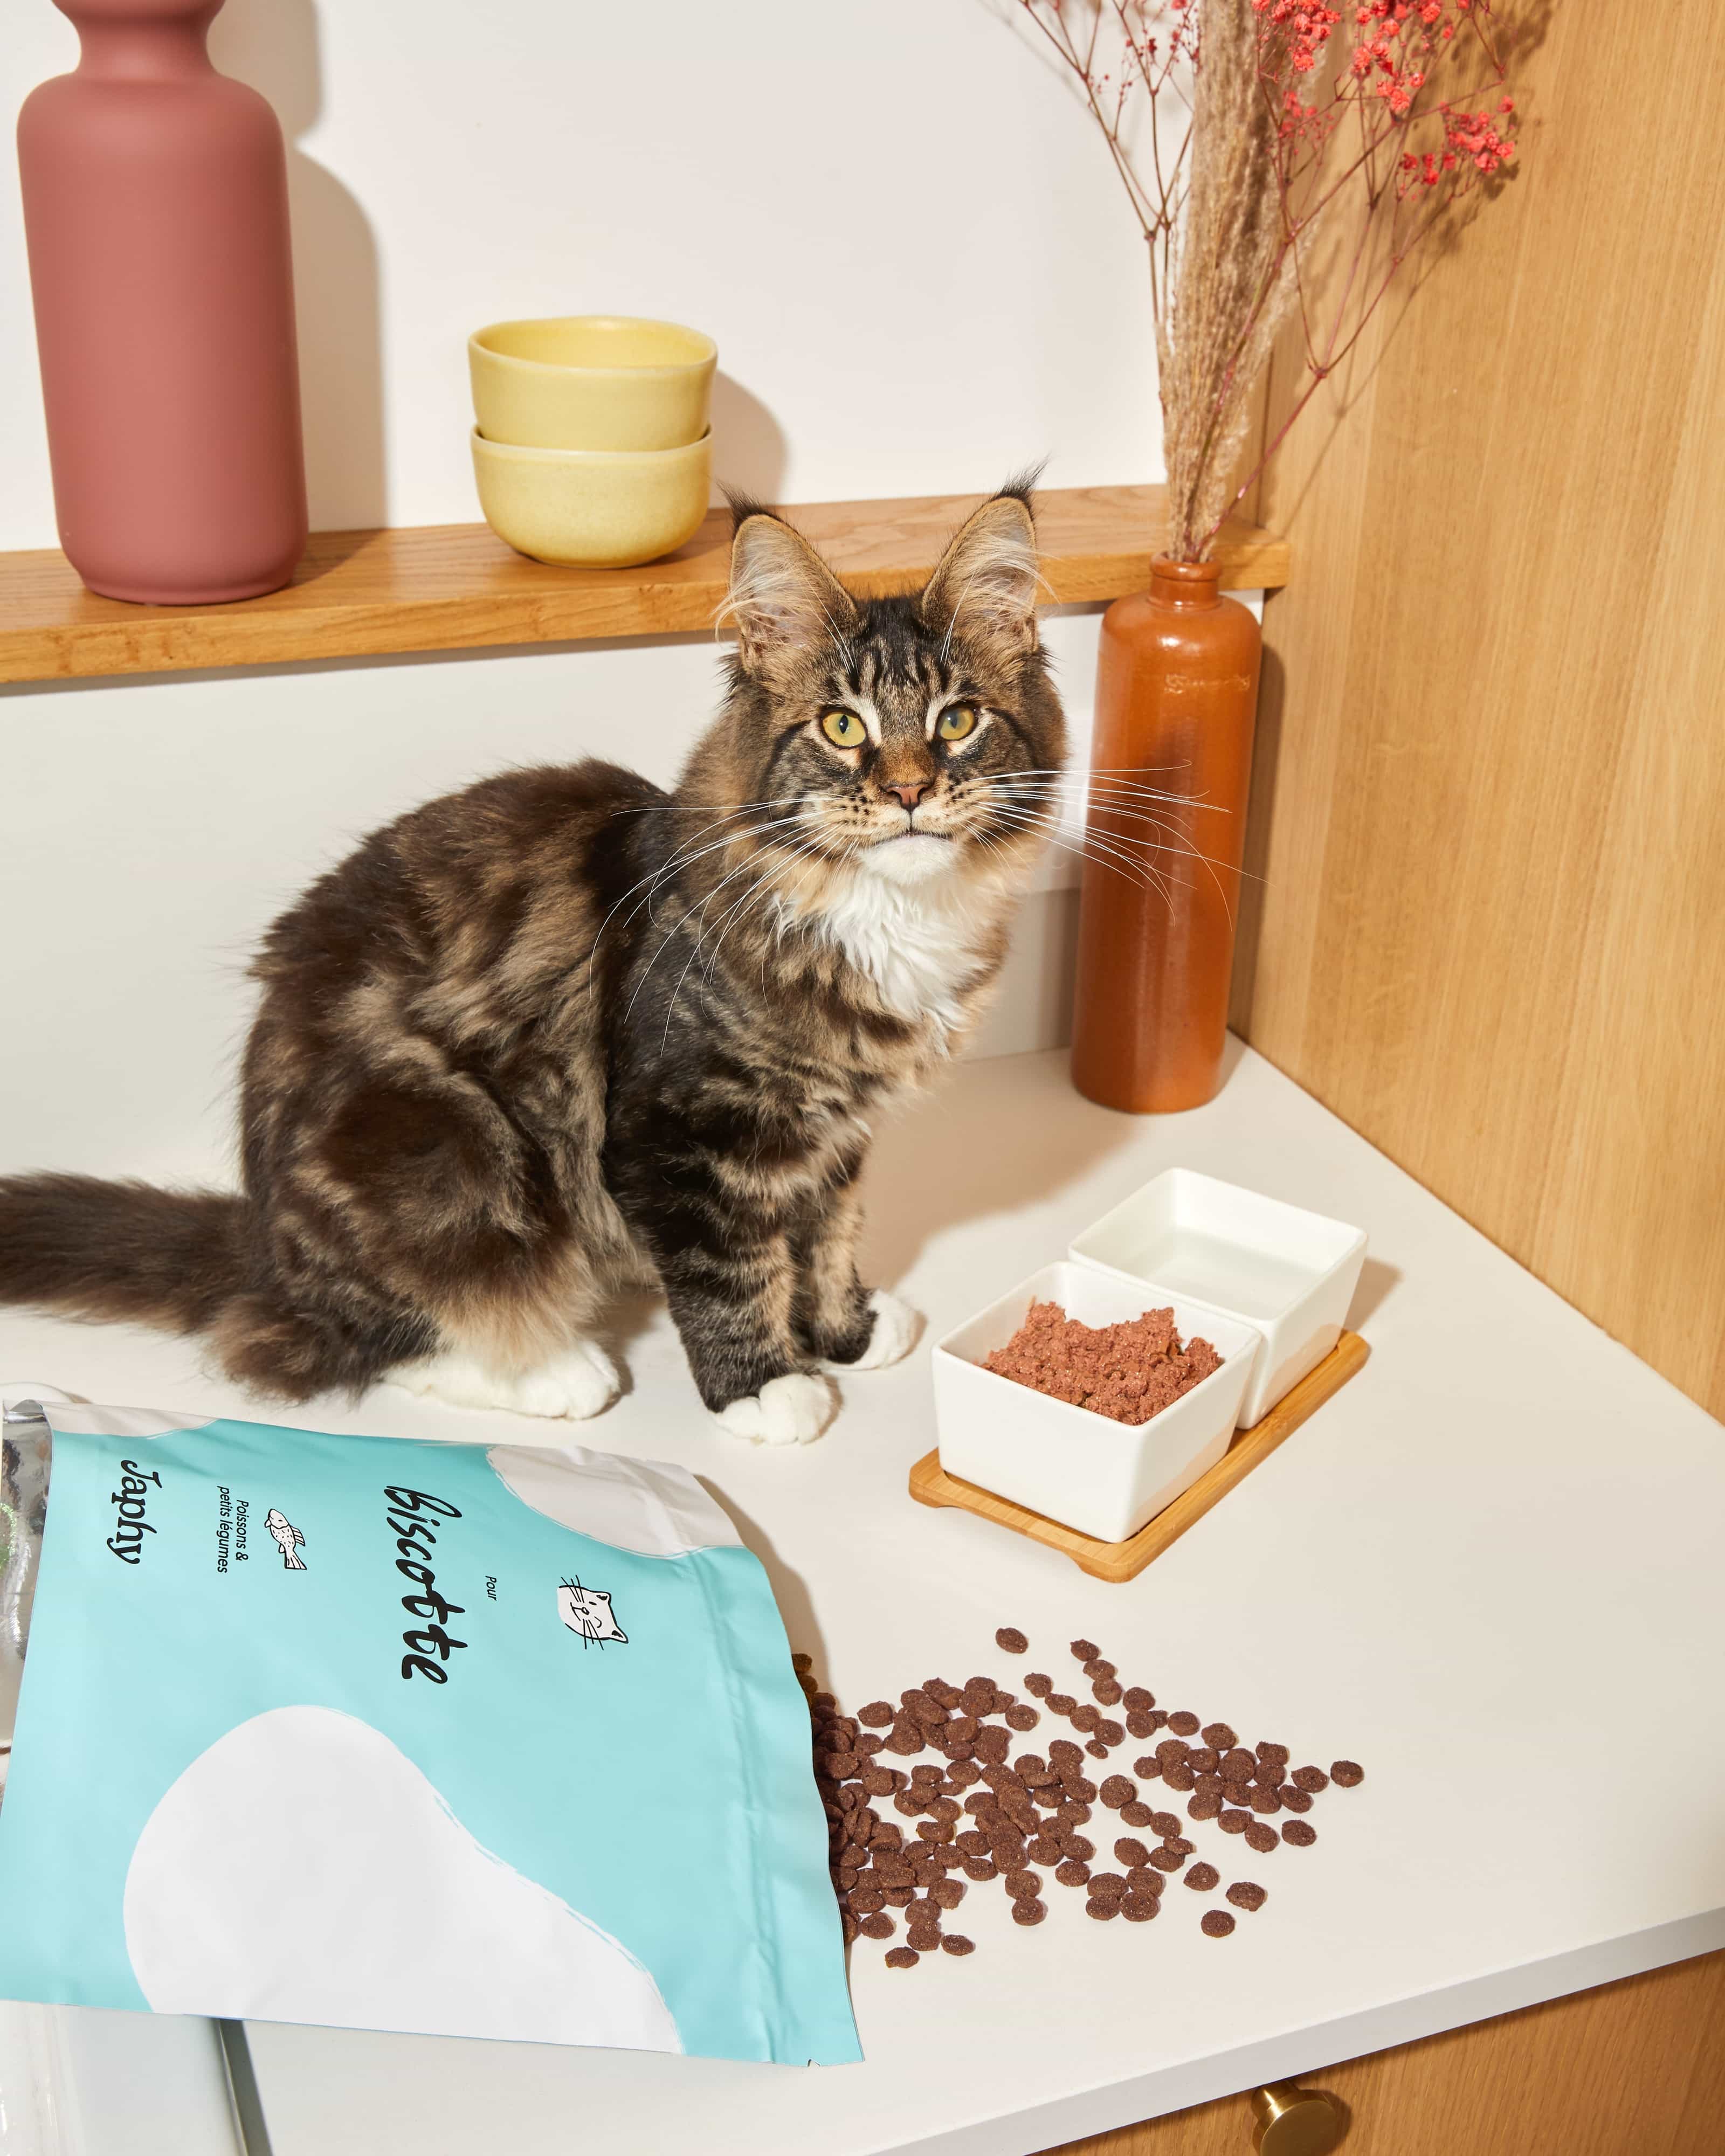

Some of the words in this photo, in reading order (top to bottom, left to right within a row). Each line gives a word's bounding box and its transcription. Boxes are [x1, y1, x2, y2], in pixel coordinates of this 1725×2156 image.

[107, 1460, 162, 1564] Japhy
[217, 1485, 233, 1517] petits
[236, 1499, 250, 1550] Poissons
[216, 1519, 233, 1573] légumes
[235, 1552, 249, 1561] &
[384, 1485, 468, 1684] Biscotte
[485, 1575, 497, 1601] Pour
